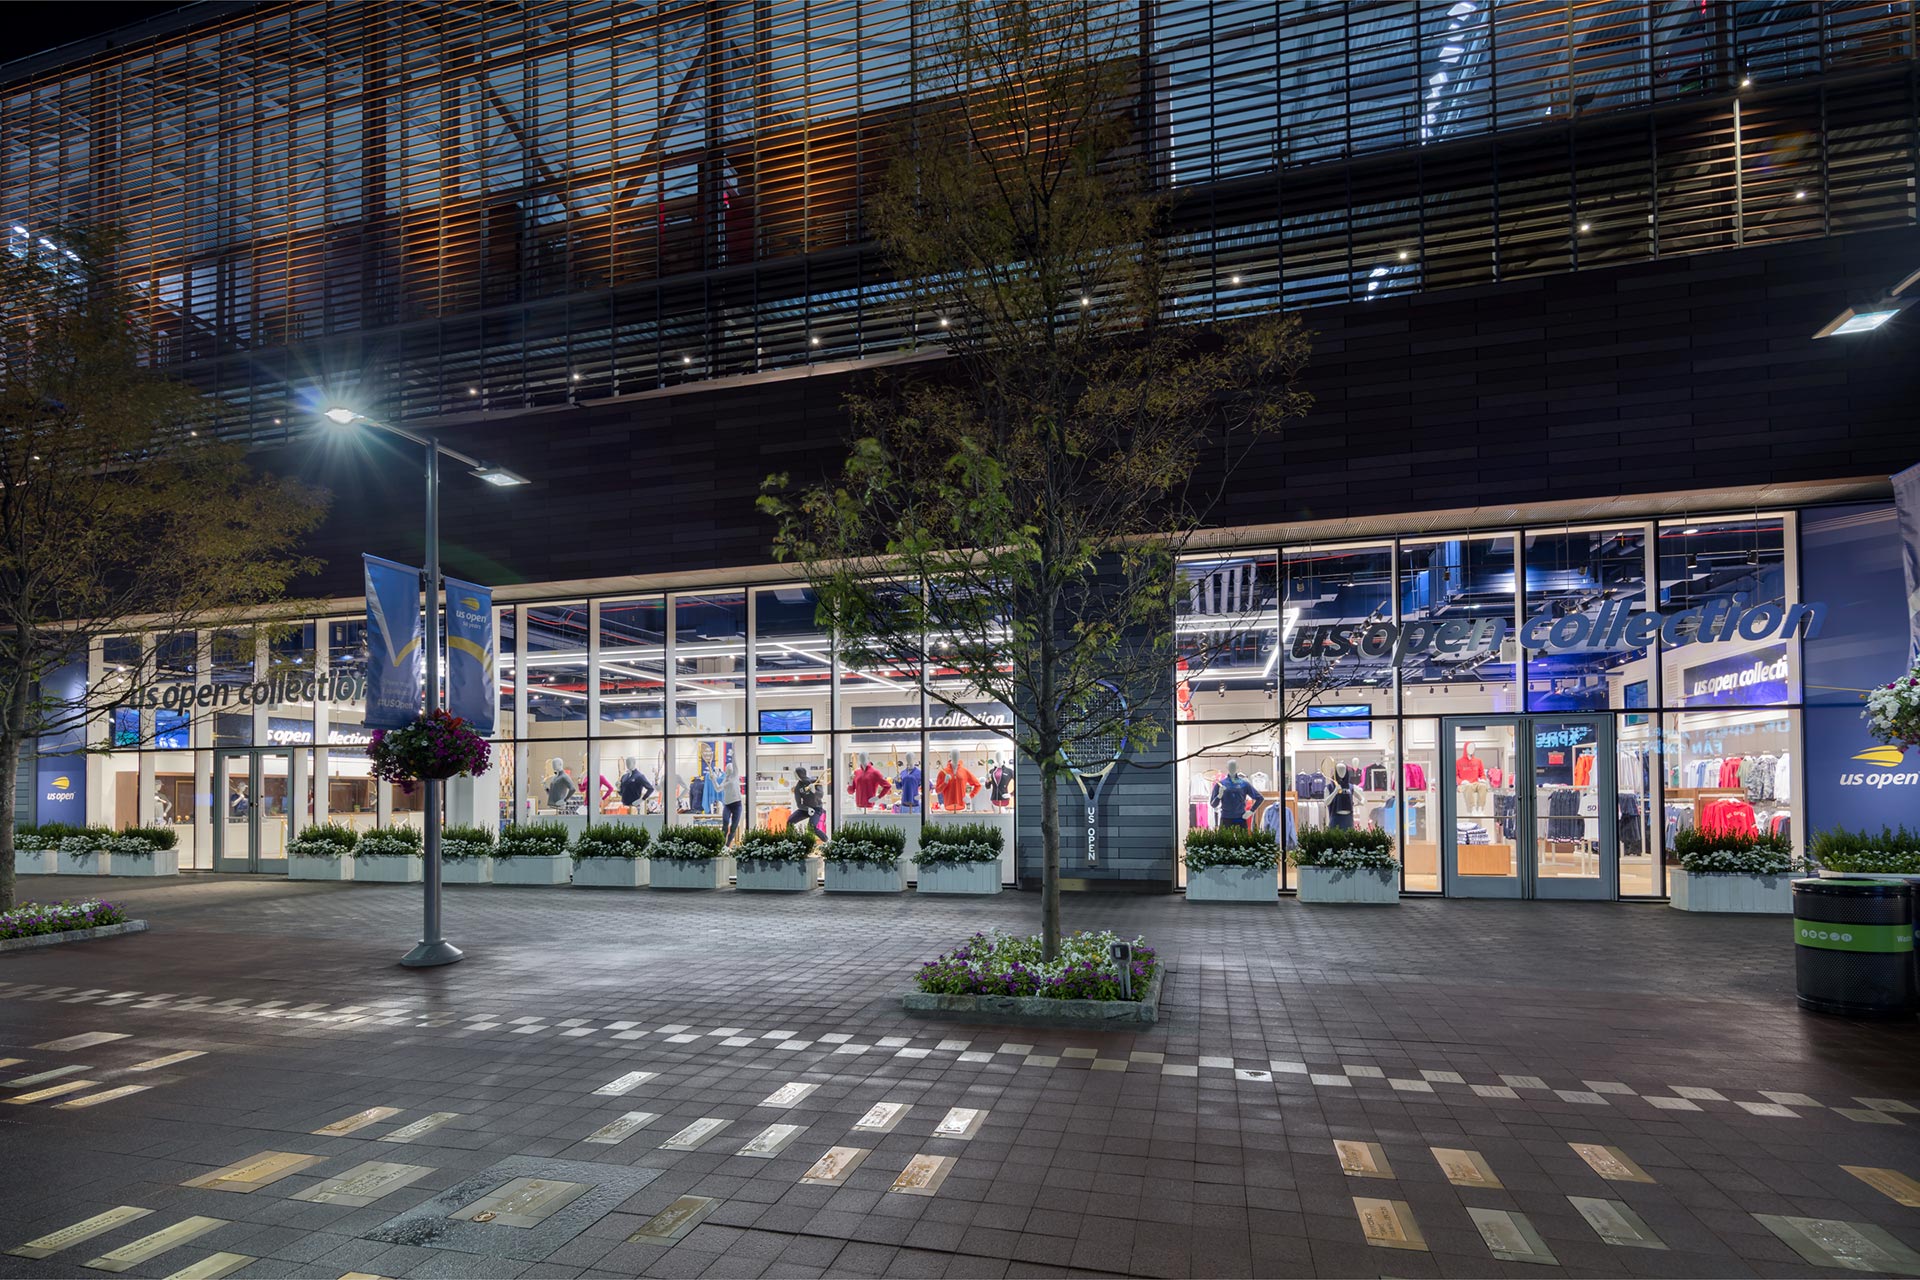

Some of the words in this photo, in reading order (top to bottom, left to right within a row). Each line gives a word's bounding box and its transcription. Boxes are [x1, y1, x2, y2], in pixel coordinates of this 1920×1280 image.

[456, 610, 465, 619] us
[466, 612, 487, 624] open
[1290, 624, 1353, 663] us
[1357, 616, 1508, 668] open
[1520, 592, 1828, 649] collection
[1693, 680, 1707, 696] us
[1707, 672, 1738, 697] open
[1739, 654, 1788, 687] collecti
[162, 683, 230, 717] open
[879, 717, 896, 729] us
[273, 730, 312, 745] open
[1840, 773, 1864, 786] us
[1865, 773, 1919, 789] open
[56, 792, 75, 802] open
[1087, 807, 1096, 824] US
[1087, 827, 1096, 861] OPEN
